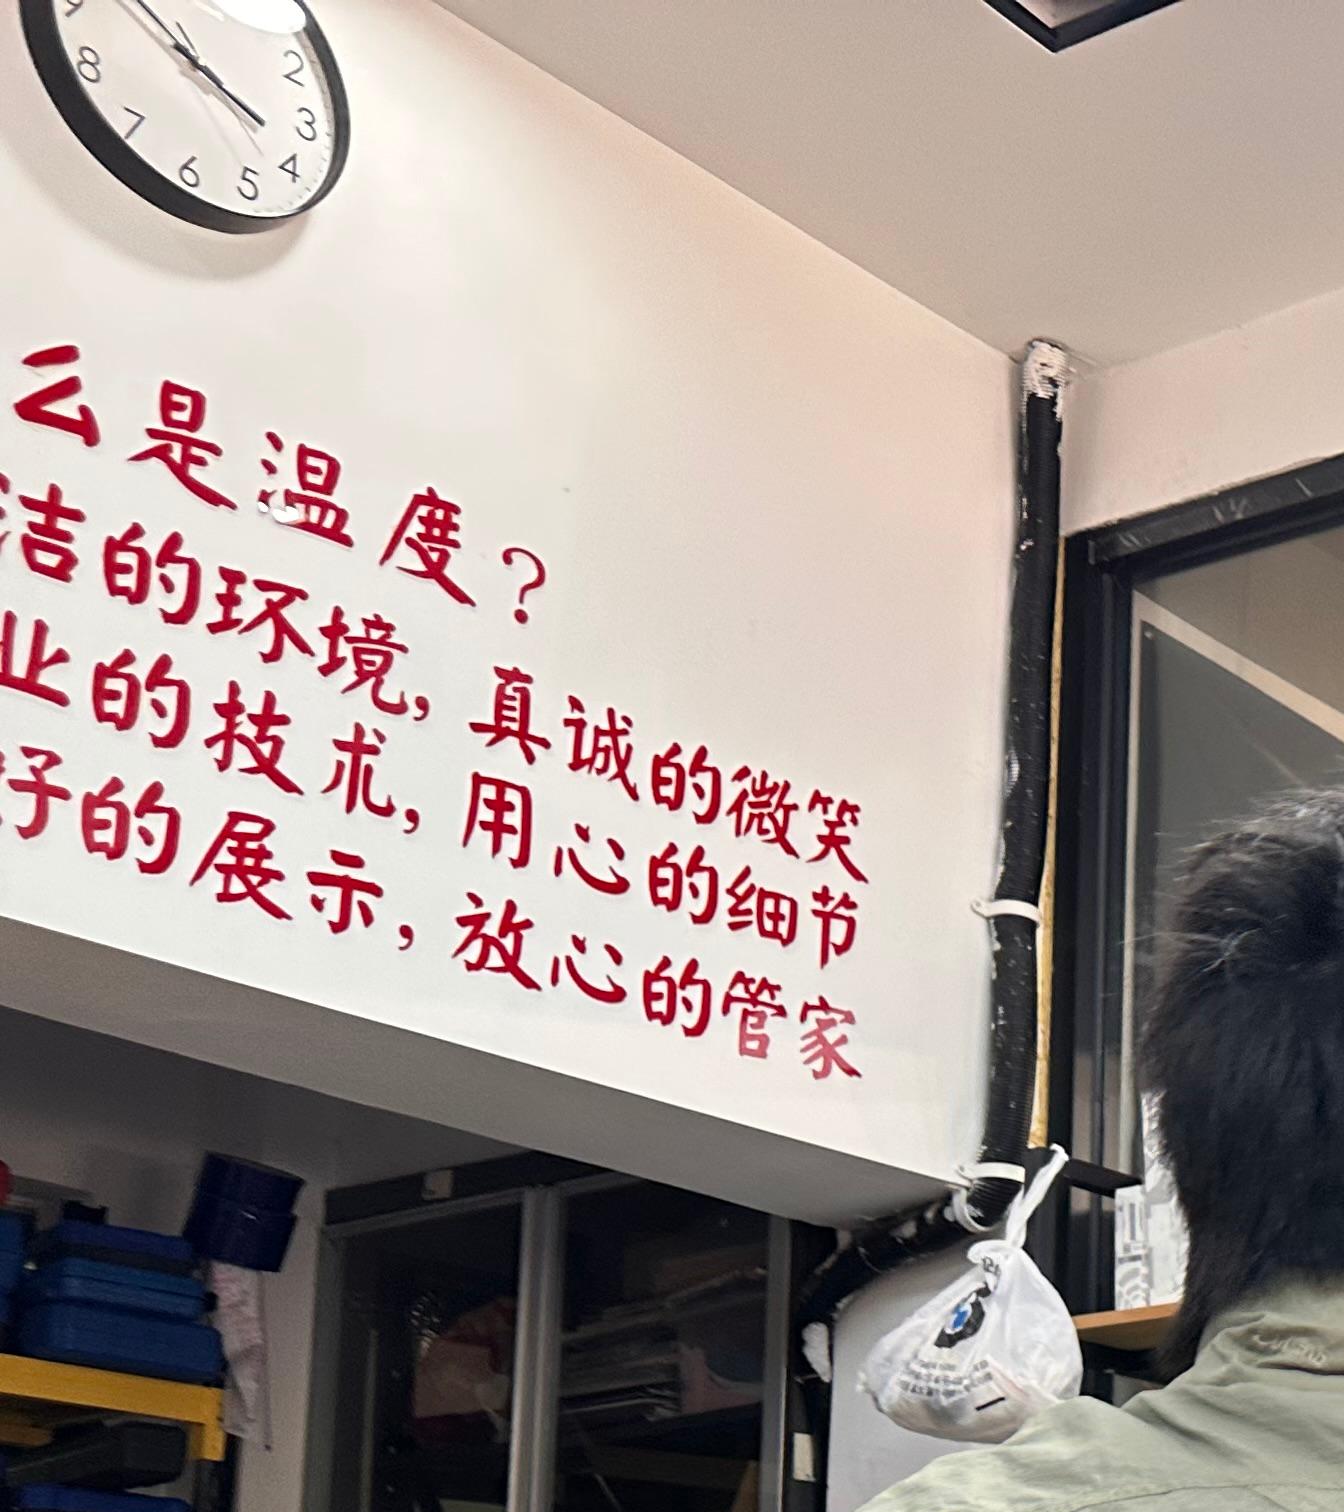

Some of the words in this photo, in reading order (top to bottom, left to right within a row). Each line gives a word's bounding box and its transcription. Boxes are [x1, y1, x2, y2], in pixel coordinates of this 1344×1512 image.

[77, 46, 100, 83] 8
[283, 50, 304, 86] 2
[123, 107, 146, 139] 7
[297, 107, 317, 141] 3
[178, 156, 200, 188] 6
[237, 166, 259, 201] 5
[278, 154, 300, 183] 4
[12, 344, 547, 625] 么是温度？
